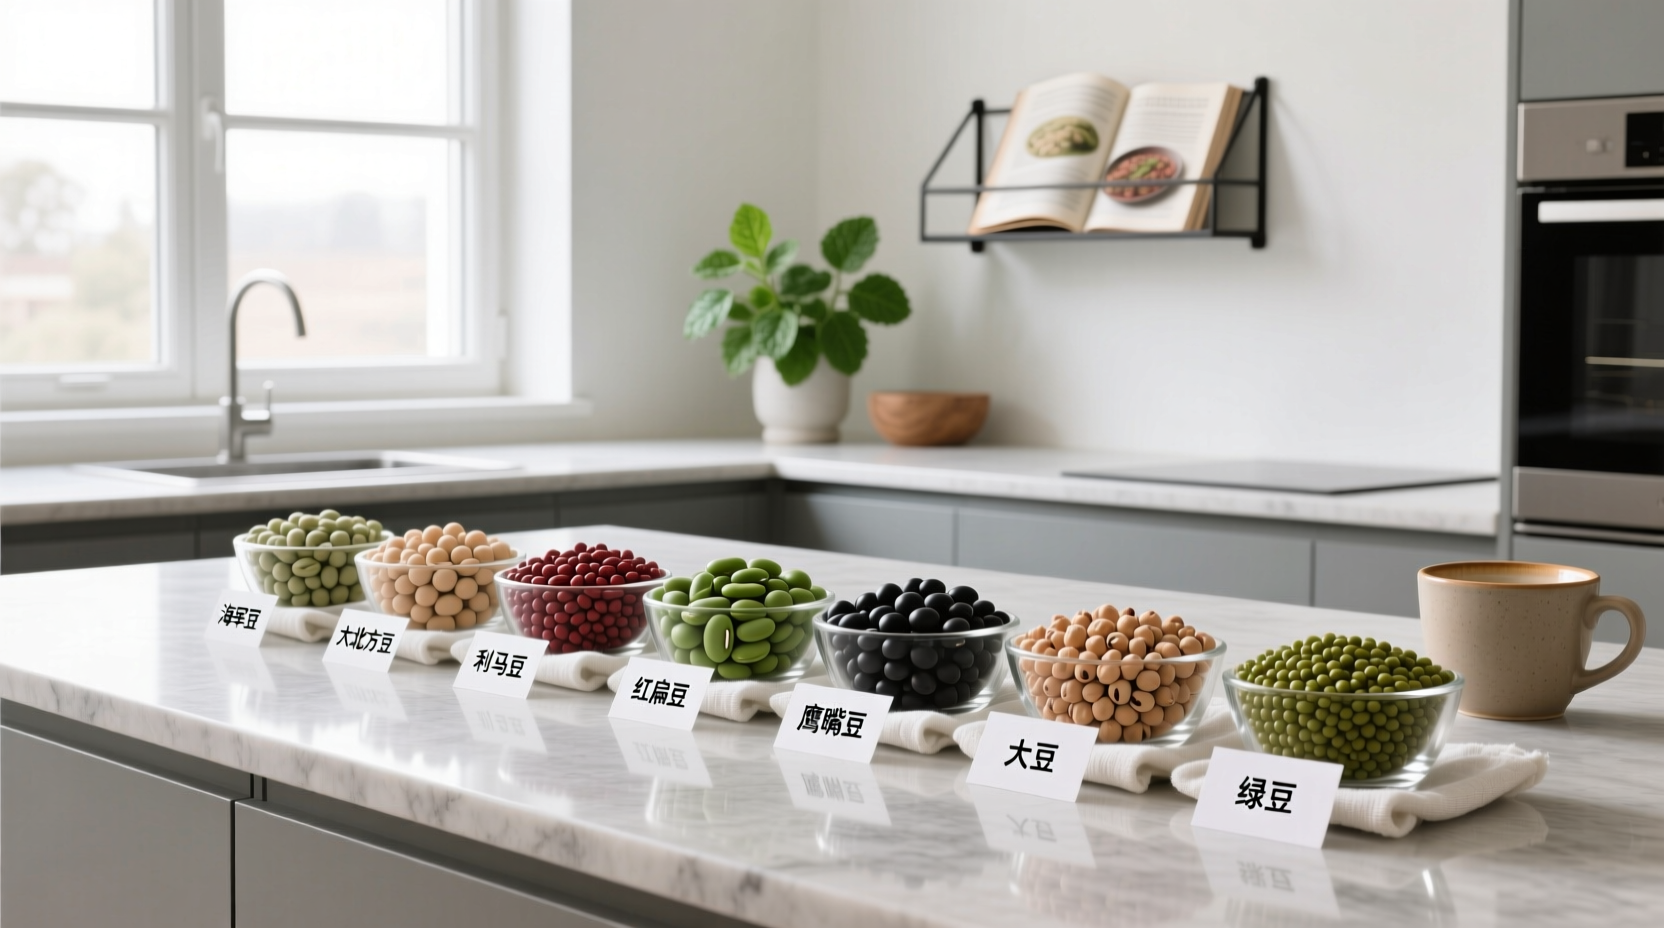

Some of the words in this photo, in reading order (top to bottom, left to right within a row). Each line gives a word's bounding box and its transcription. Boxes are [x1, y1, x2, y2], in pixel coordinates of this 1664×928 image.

[336, 625, 395, 654] 大北方豆
[474, 650, 527, 679] 利马豆
[631, 677, 690, 708] 红扁豆
[797, 703, 867, 738] 鹰嘴豆
[1004, 739, 1059, 773] 大豆
[1235, 776, 1297, 814] 绿豆
